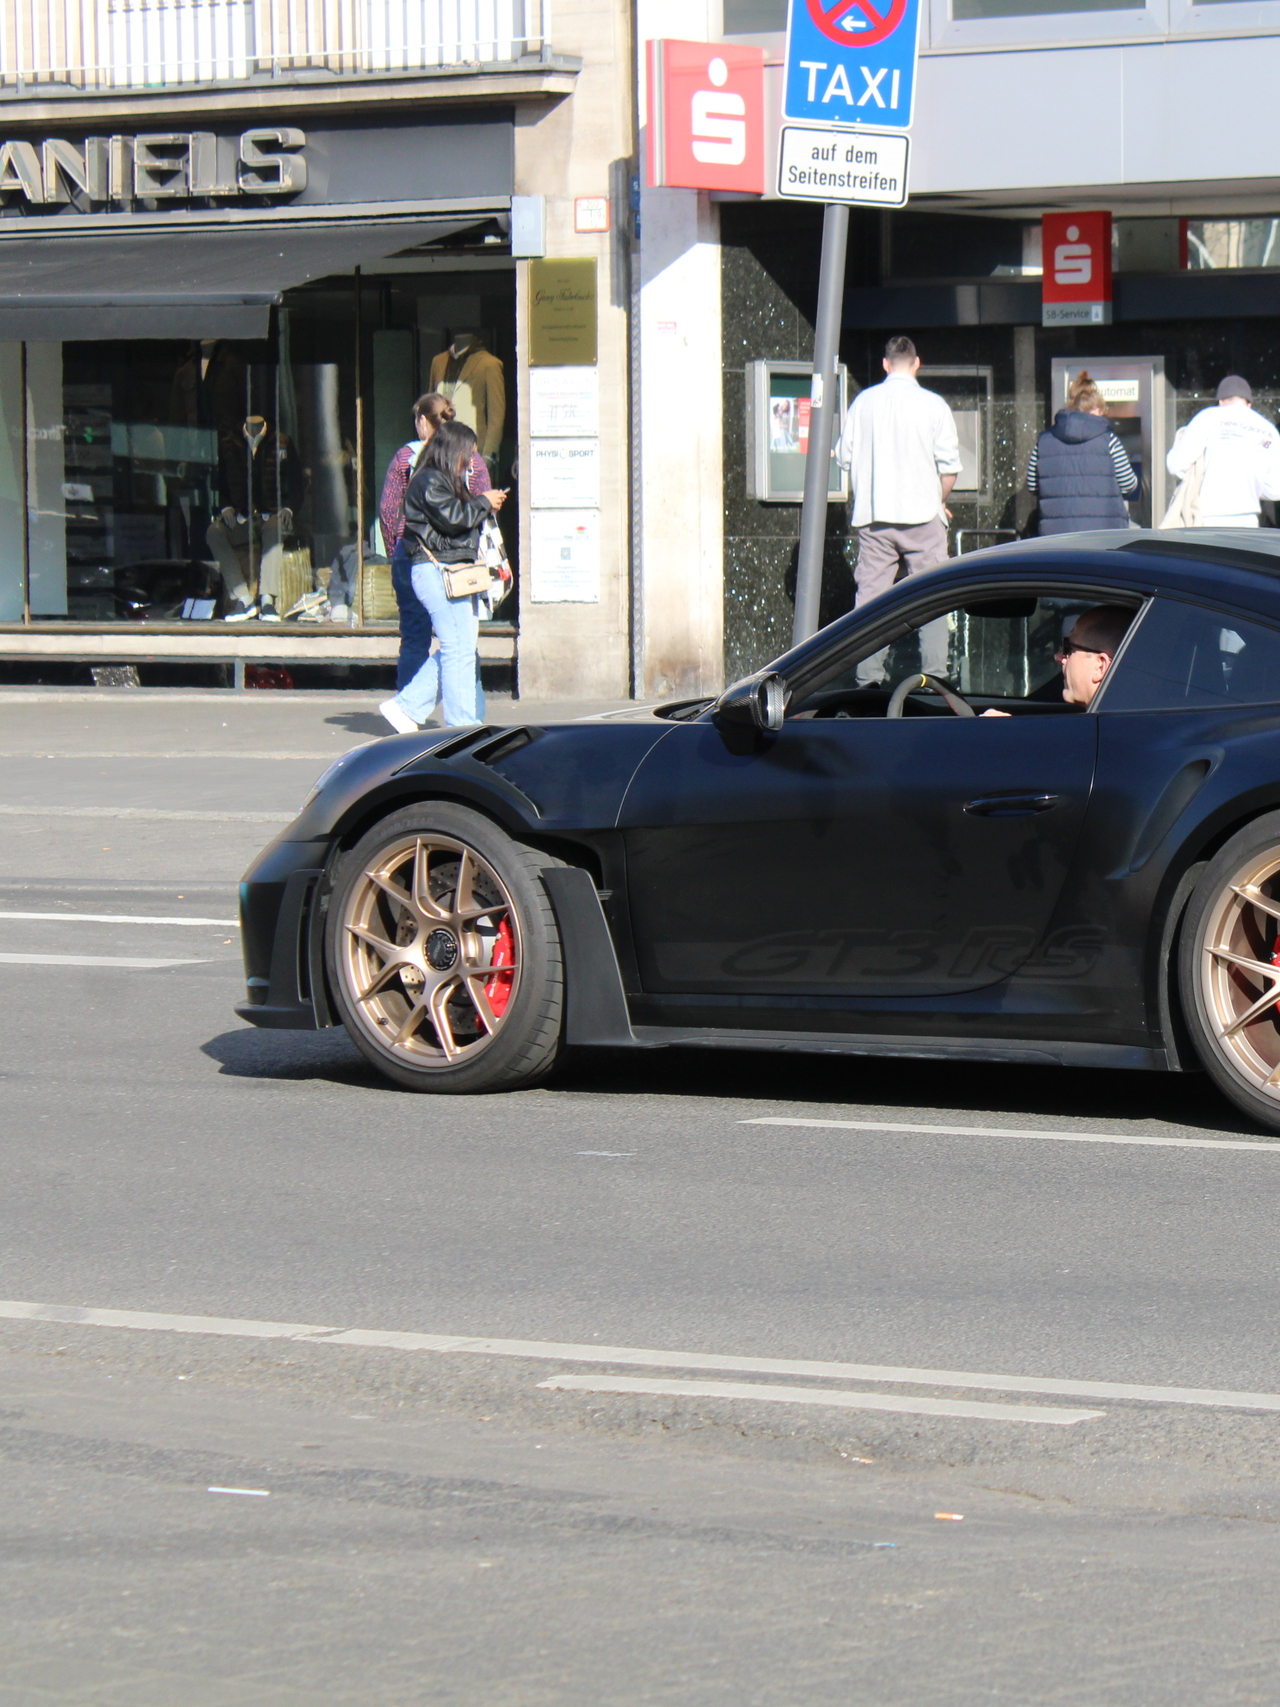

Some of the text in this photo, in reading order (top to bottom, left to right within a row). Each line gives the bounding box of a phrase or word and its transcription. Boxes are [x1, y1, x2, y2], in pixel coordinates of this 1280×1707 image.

[799, 61, 901, 109] TAXI
[0, 128, 307, 205] ANIELS
[811, 144, 878, 165] auf dem
[788, 165, 898, 192] Seitenstreifen
[1046, 309, 1090, 320] SB-Service
[1098, 387, 1136, 397] utomat
